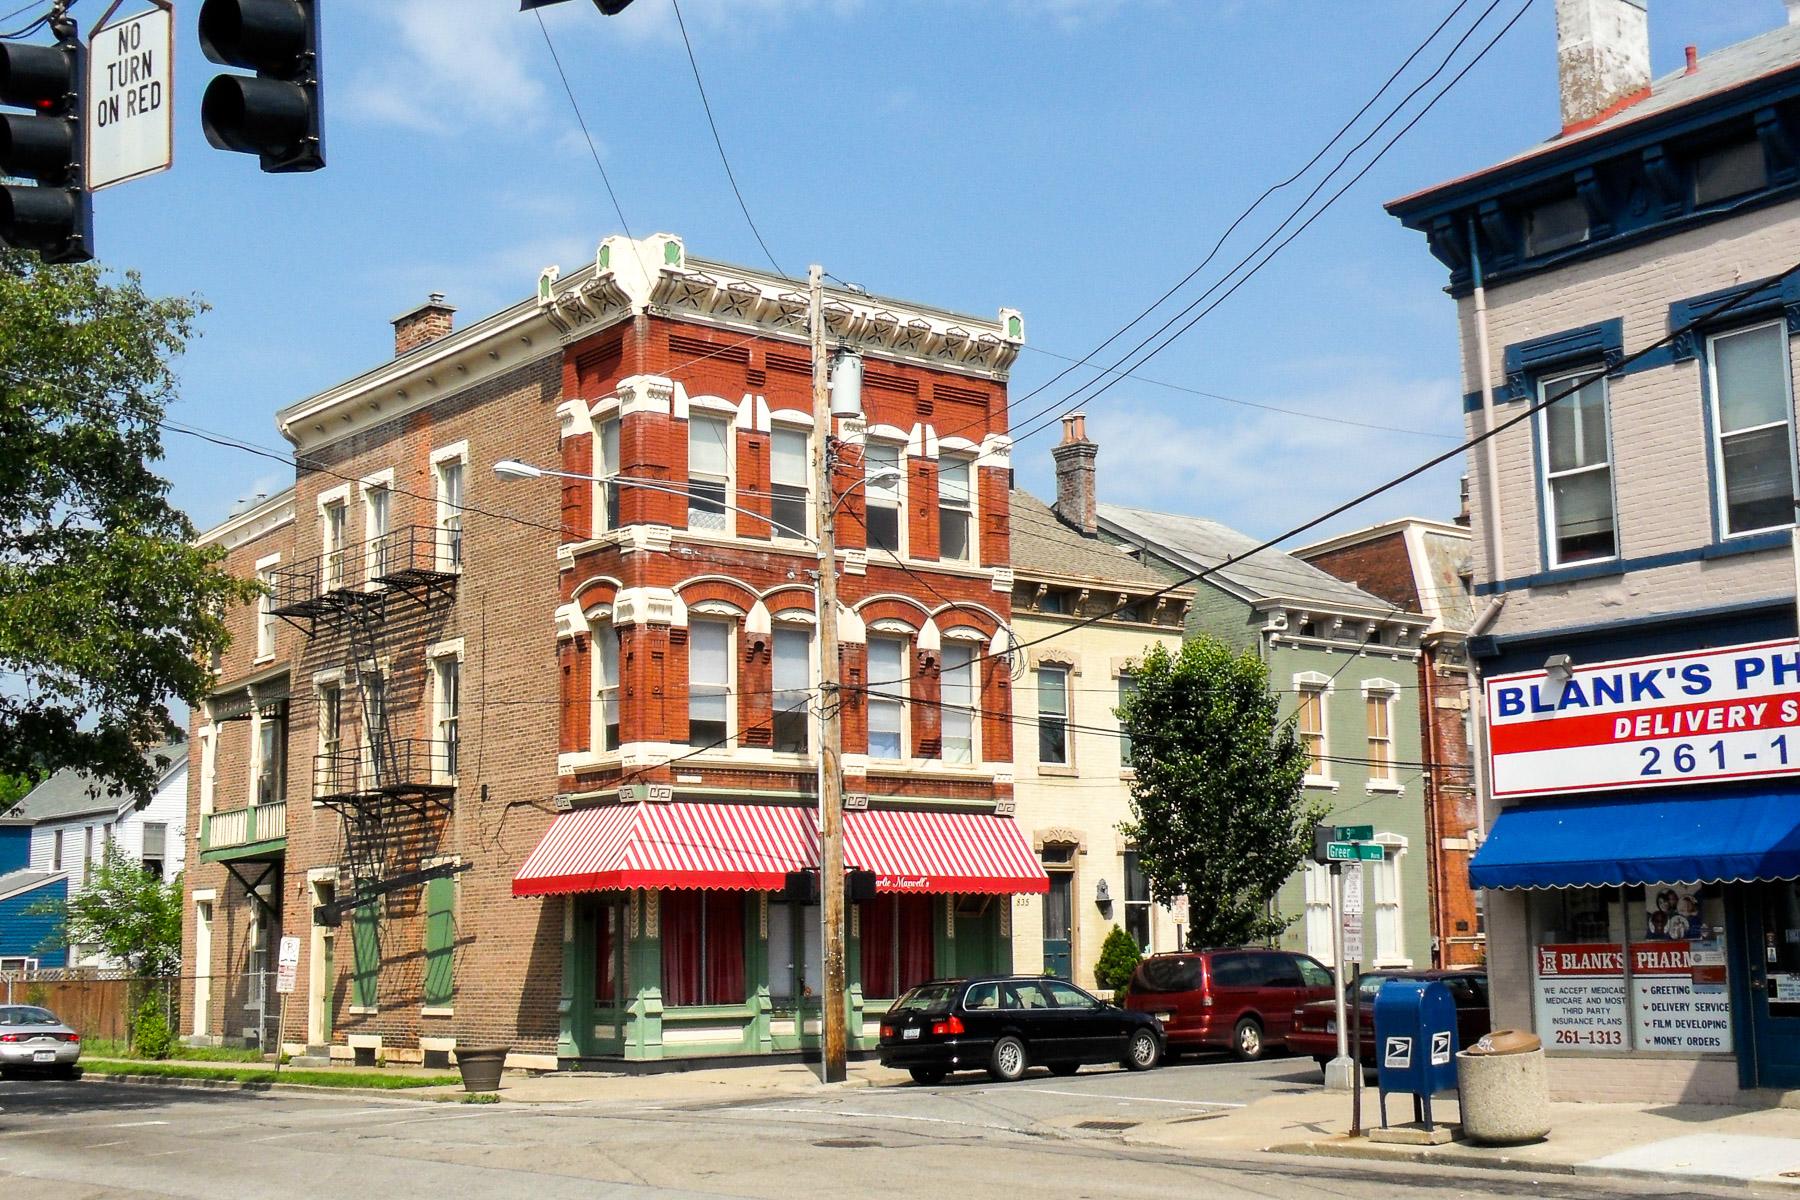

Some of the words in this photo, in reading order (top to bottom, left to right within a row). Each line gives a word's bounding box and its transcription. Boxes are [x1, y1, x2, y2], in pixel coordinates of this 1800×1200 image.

[118, 22, 141, 56] NO
[107, 50, 152, 91] TURN
[97, 94, 119, 128] ON
[127, 81, 162, 118] RED
[1497, 663, 1712, 717] BLANK'S
[1734, 651, 1800, 690] PH
[1614, 702, 1768, 739] DELIVERY
[1780, 700, 1799, 723] S
[1639, 734, 1788, 776] 261-1
[1561, 952, 1624, 970] BLANK'S
[1591, 986, 1626, 995] MEDICAID
[1650, 986, 1690, 995] GREETING
[1545, 997, 1582, 1005] MEDICARE
[1586, 997, 1601, 1005] AND
[1604, 997, 1626, 1005] MOST
[1562, 1007, 1583, 1015] THIRD
[1586, 1007, 1611, 1015] PARTY
[1651, 1003, 1690, 1012] DELIVERY
[1695, 1003, 1729, 1012] SERVICE
[1552, 1017, 1593, 1025] INSURANCE
[1597, 1017, 1622, 1026] PLANS
[1653, 1019, 1672, 1029] FILM
[1675, 1019, 1727, 1029] DEVELOPING
[1555, 1030, 1622, 1045] 261-1313
[1654, 1036, 1682, 1046] MONEY
[1687, 1036, 1721, 1046] ORDERS
